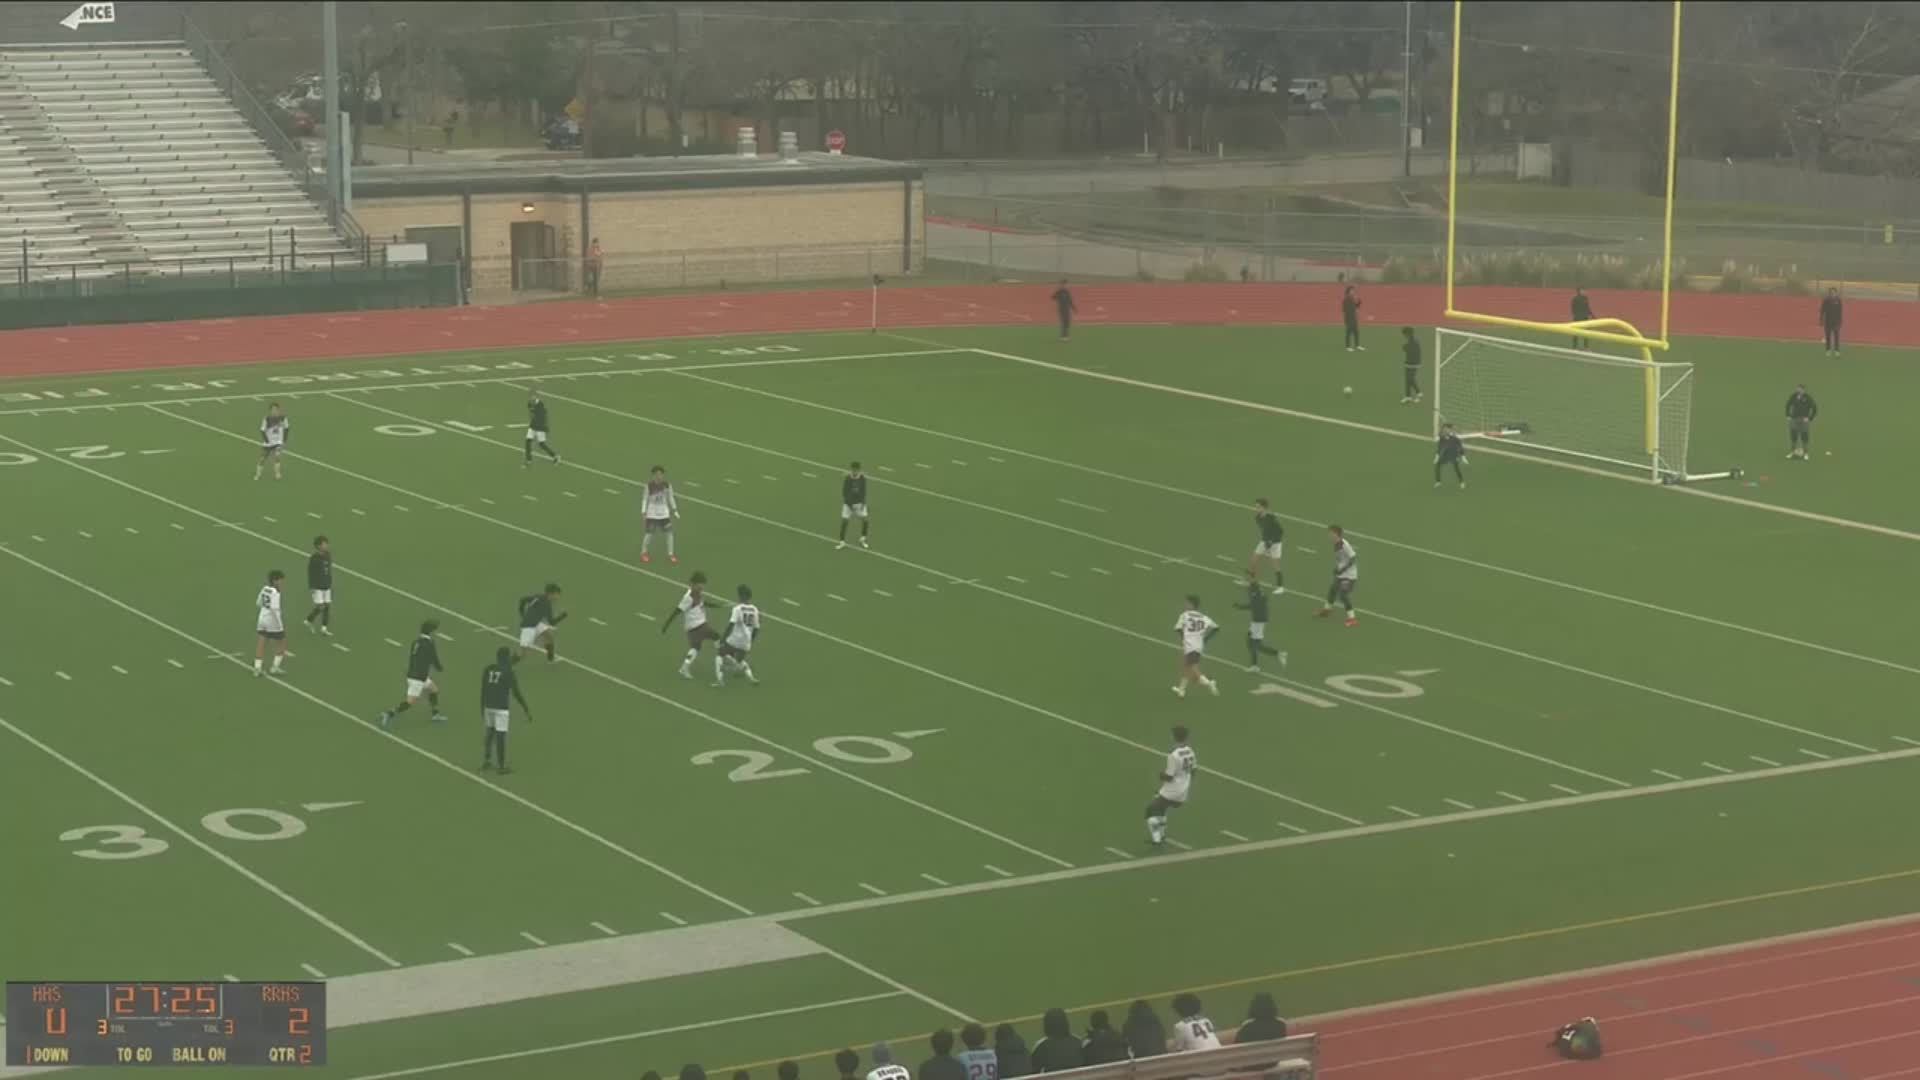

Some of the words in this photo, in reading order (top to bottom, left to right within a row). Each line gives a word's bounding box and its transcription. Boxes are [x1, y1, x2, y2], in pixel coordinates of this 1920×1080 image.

[80, 6, 112, 19] NCE
[266, 360, 534, 385] PETERS
[489, 671, 501, 684] 17
[1248, 674, 1424, 707] 10
[690, 735, 913, 782] 20
[59, 807, 307, 860] 30
